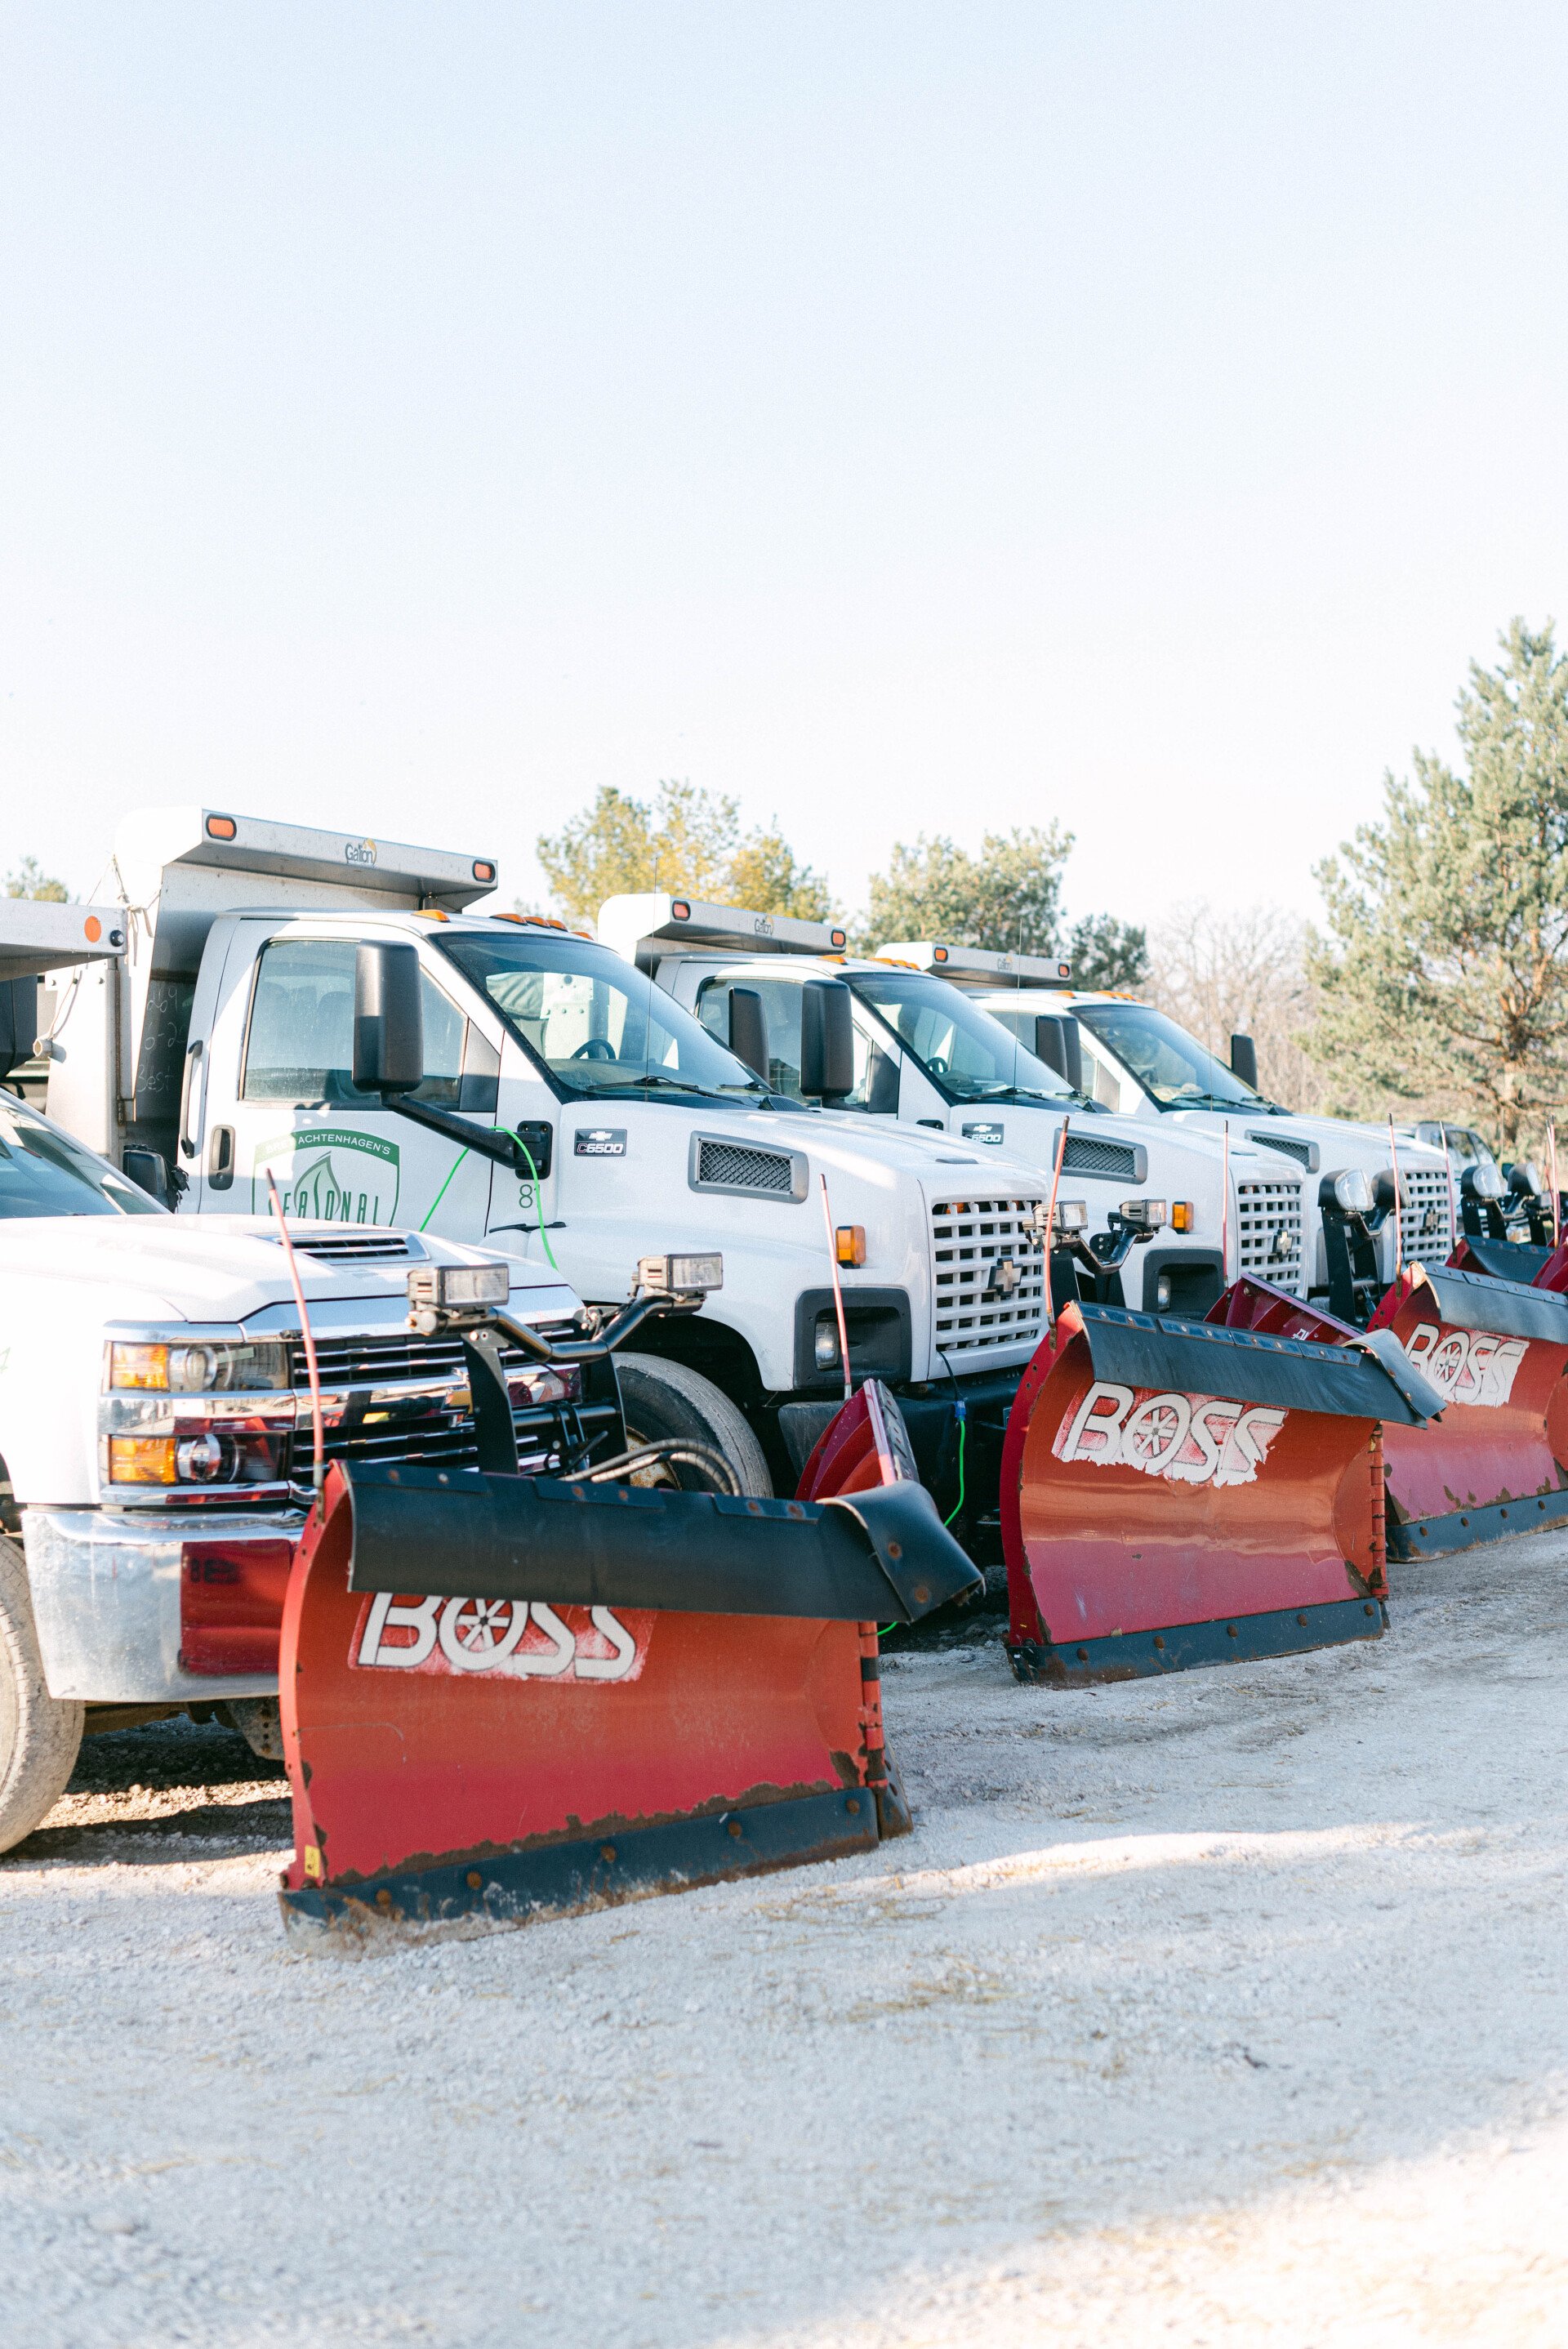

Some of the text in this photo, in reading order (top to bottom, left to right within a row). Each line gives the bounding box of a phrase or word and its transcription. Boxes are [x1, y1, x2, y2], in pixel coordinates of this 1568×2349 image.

[297, 1133, 391, 1156] ACHTENHAGEN'S
[577, 1143, 623, 1153] C6500
[268, 1190, 380, 1226] EASONAL
[519, 1183, 541, 1209] 8
[1403, 1322, 1526, 1406] BOSS
[1062, 1381, 1286, 1484] BOSS
[359, 1593, 636, 1680] BOSS
